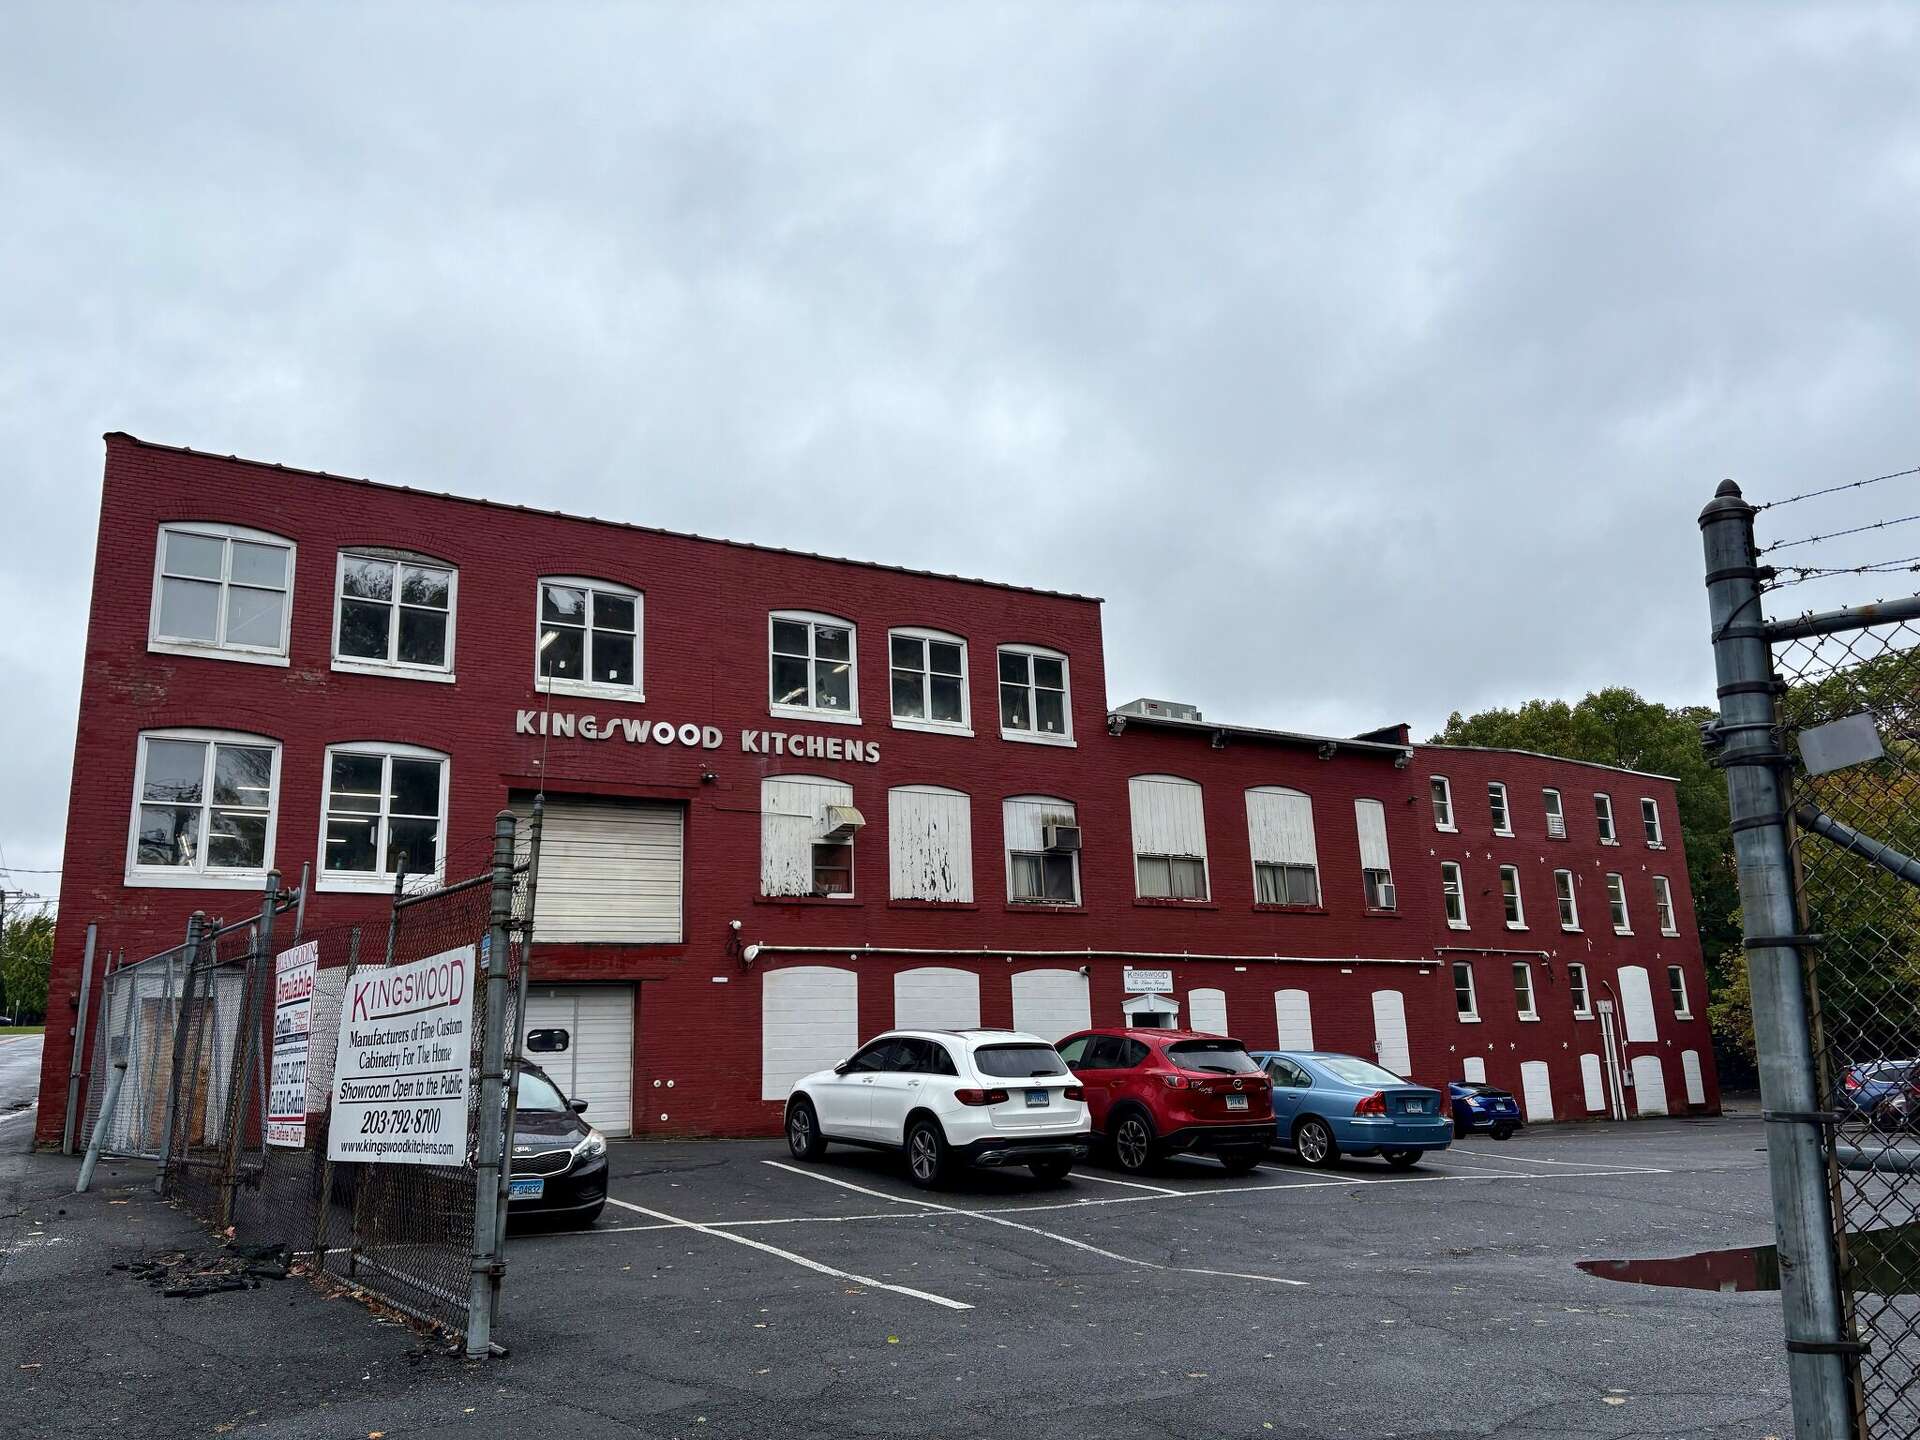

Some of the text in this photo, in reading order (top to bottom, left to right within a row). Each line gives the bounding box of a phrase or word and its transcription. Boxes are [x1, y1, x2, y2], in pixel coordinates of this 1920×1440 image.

[515, 709, 881, 763] KINGSWOOD KITCHENS
[277, 969, 313, 1003] Available
[351, 959, 465, 1023] KINGSWOOD
[349, 1017, 463, 1049] Manufacturers of Fine Custom
[359, 1042, 453, 1071] Cabinetry For The Home
[287, 1087, 305, 1115] Godin
[339, 1073, 463, 1101] Showroom Open to the Public
[289, 1126, 302, 1147] Only
[340, 1138, 455, 1156] www.kingswoodkitchens.com
